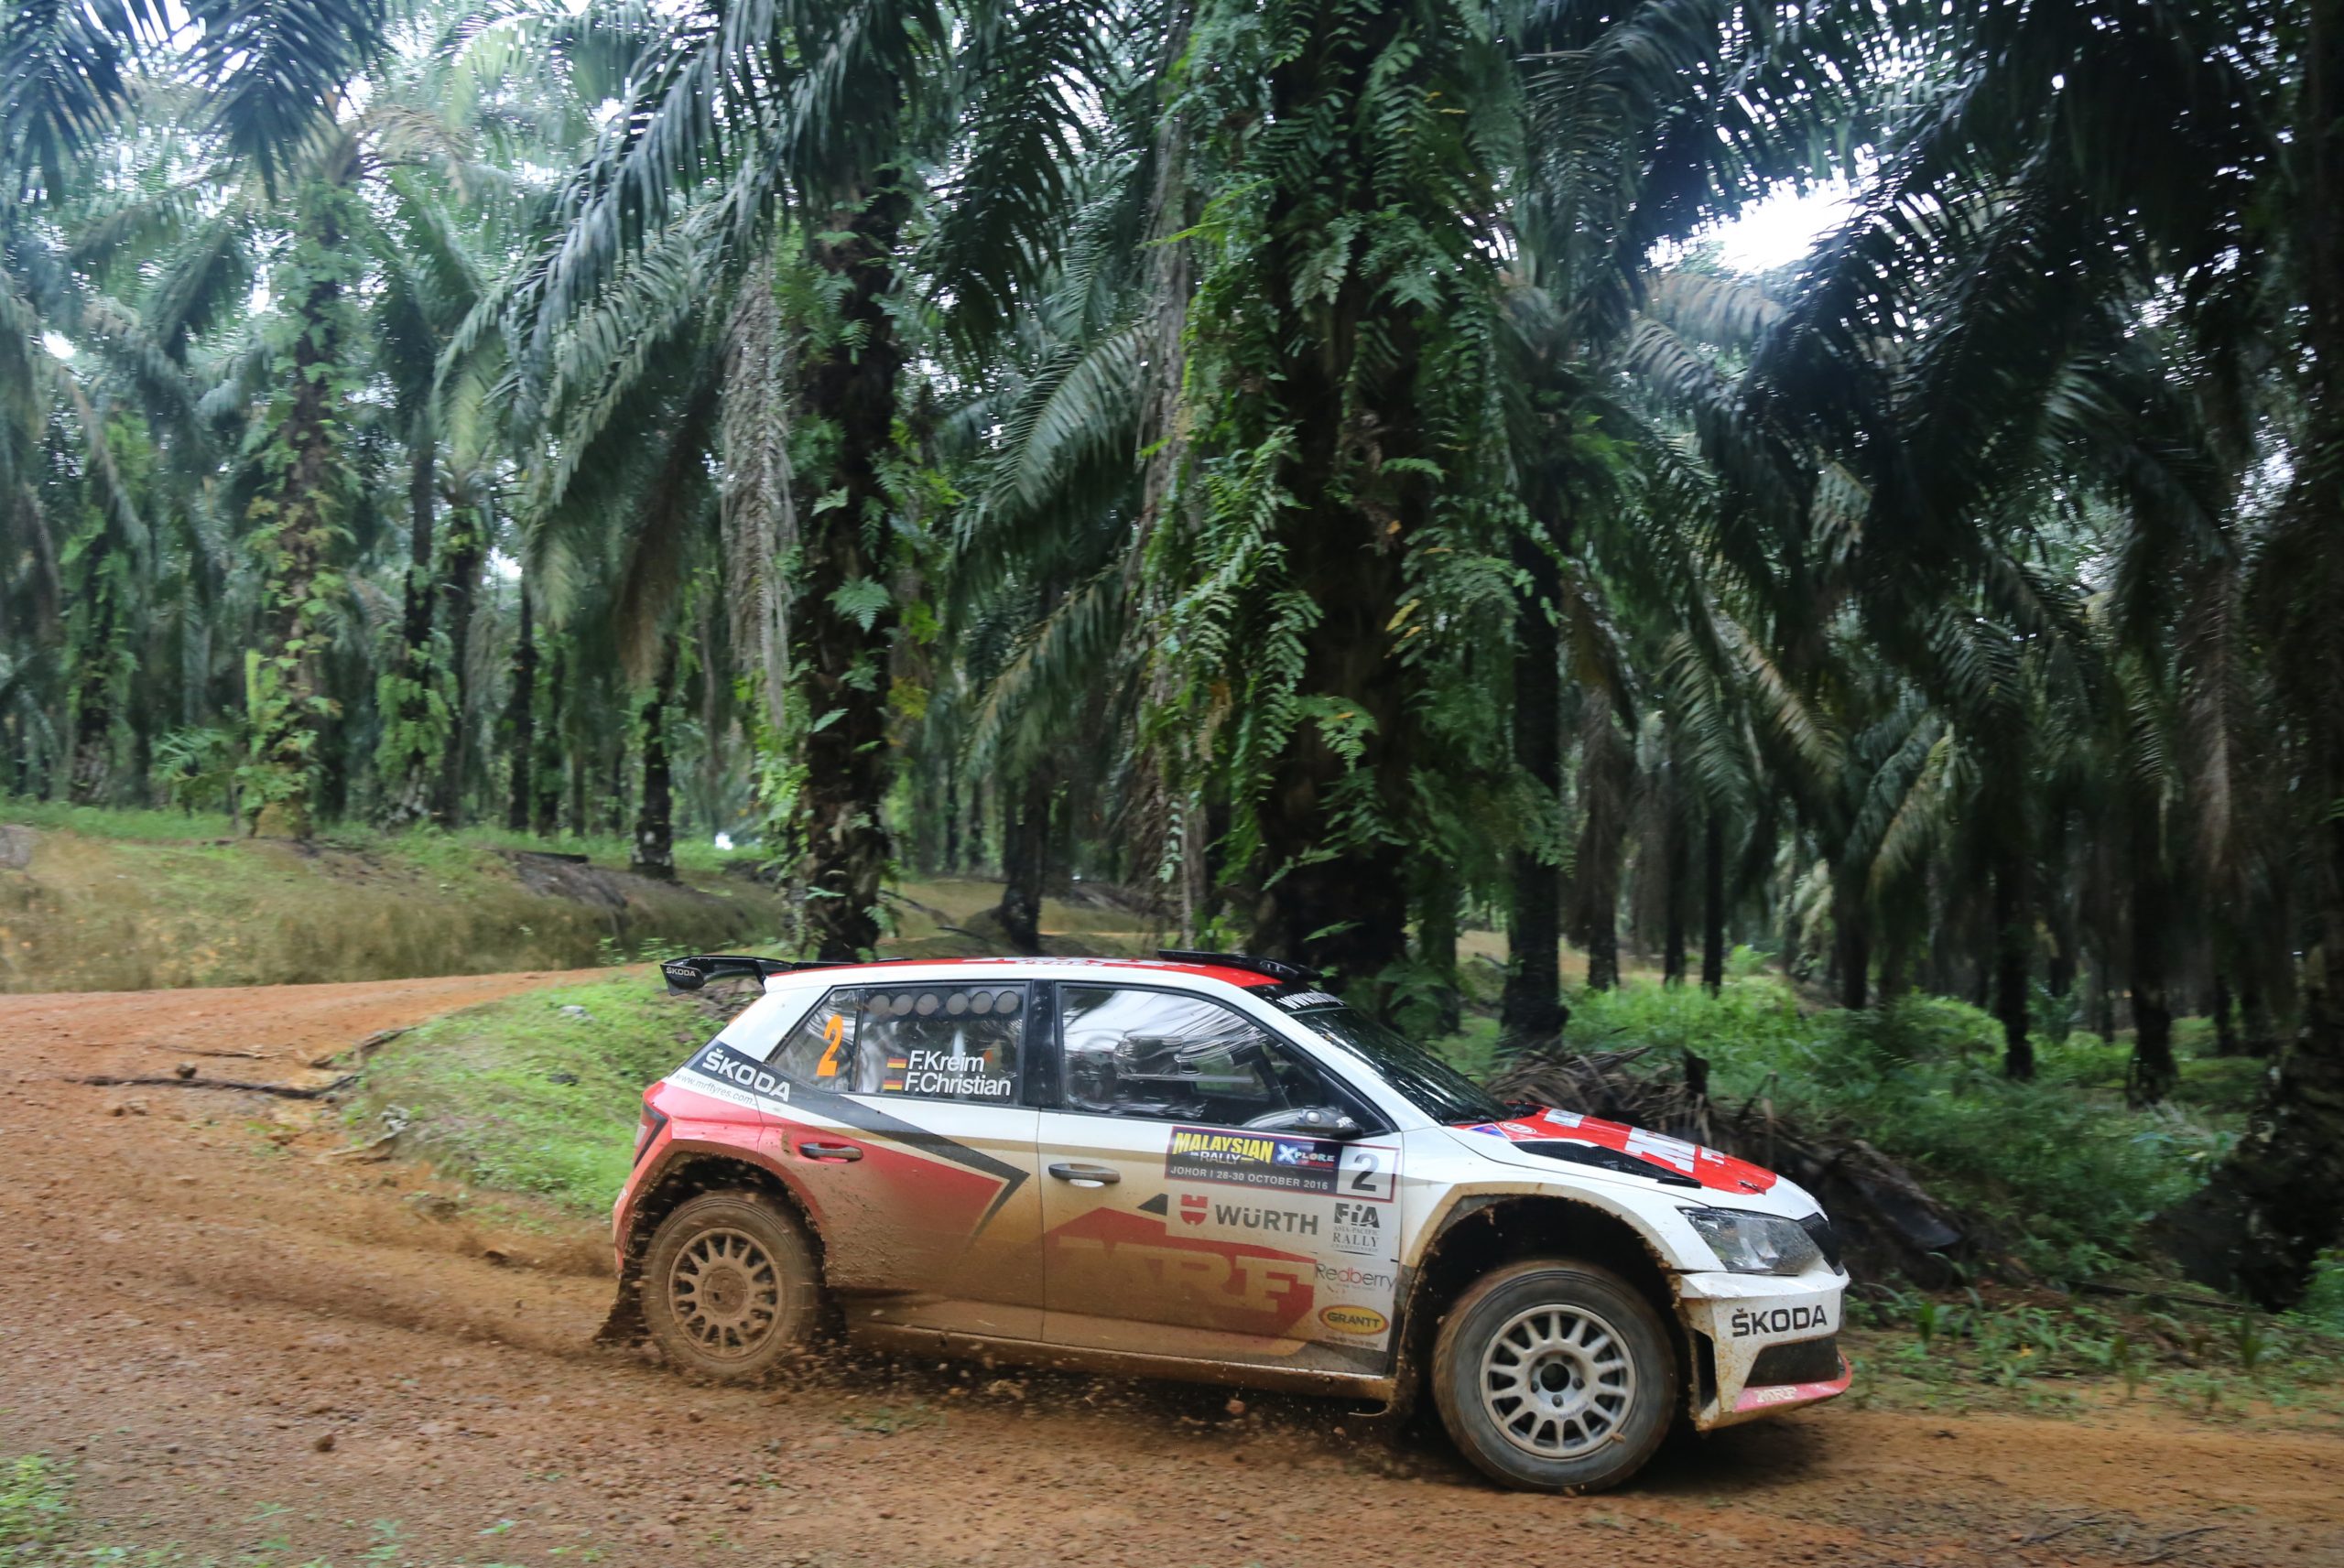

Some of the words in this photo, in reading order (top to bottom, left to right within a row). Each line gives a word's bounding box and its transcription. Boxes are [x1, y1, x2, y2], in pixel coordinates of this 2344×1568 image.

[816, 1013, 843, 1077] 2
[701, 1047, 791, 1102] ŠKODA
[908, 1050, 985, 1073] F.Kreim
[904, 1073, 1012, 1097] F.Christian
[1172, 1131, 1275, 1164] MALAYSIAN
[1199, 1151, 1242, 1165] RALLY
[1170, 1165, 1207, 1178] JOHOR
[1216, 1171, 1245, 1181] 28-30
[1247, 1173, 1300, 1187] OCTOBER
[1303, 1179, 1329, 1190] 2016
[1351, 1152, 1380, 1192] 2
[1332, 1232, 1380, 1247] RALLY
[1315, 1263, 1397, 1292] Redberry
[1327, 1312, 1381, 1328] GRANTT
[1731, 1304, 1828, 1337] ŠKODA
